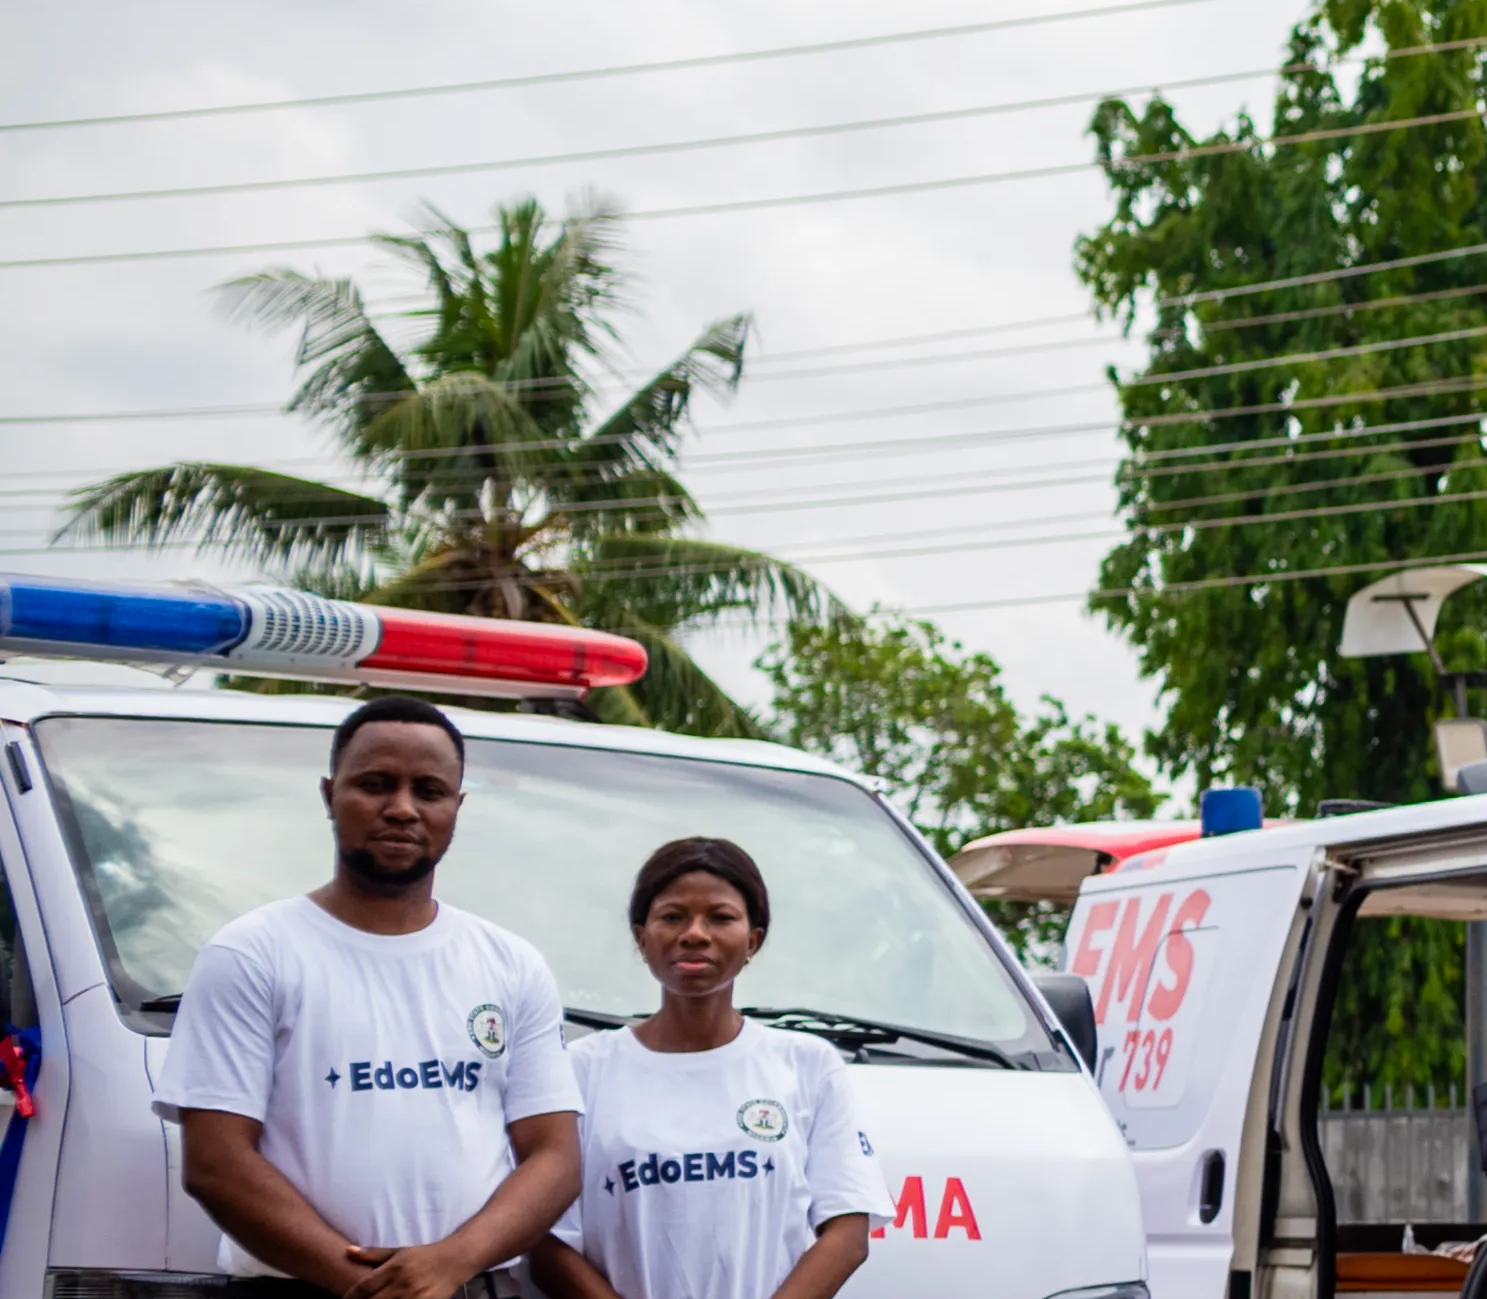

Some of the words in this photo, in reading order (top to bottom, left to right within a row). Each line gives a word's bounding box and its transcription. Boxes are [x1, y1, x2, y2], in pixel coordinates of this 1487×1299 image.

[349, 1058, 482, 1092] EdoEMS
[1118, 1026, 1174, 1093] 739
[618, 1149, 758, 1193] EdoEMS
